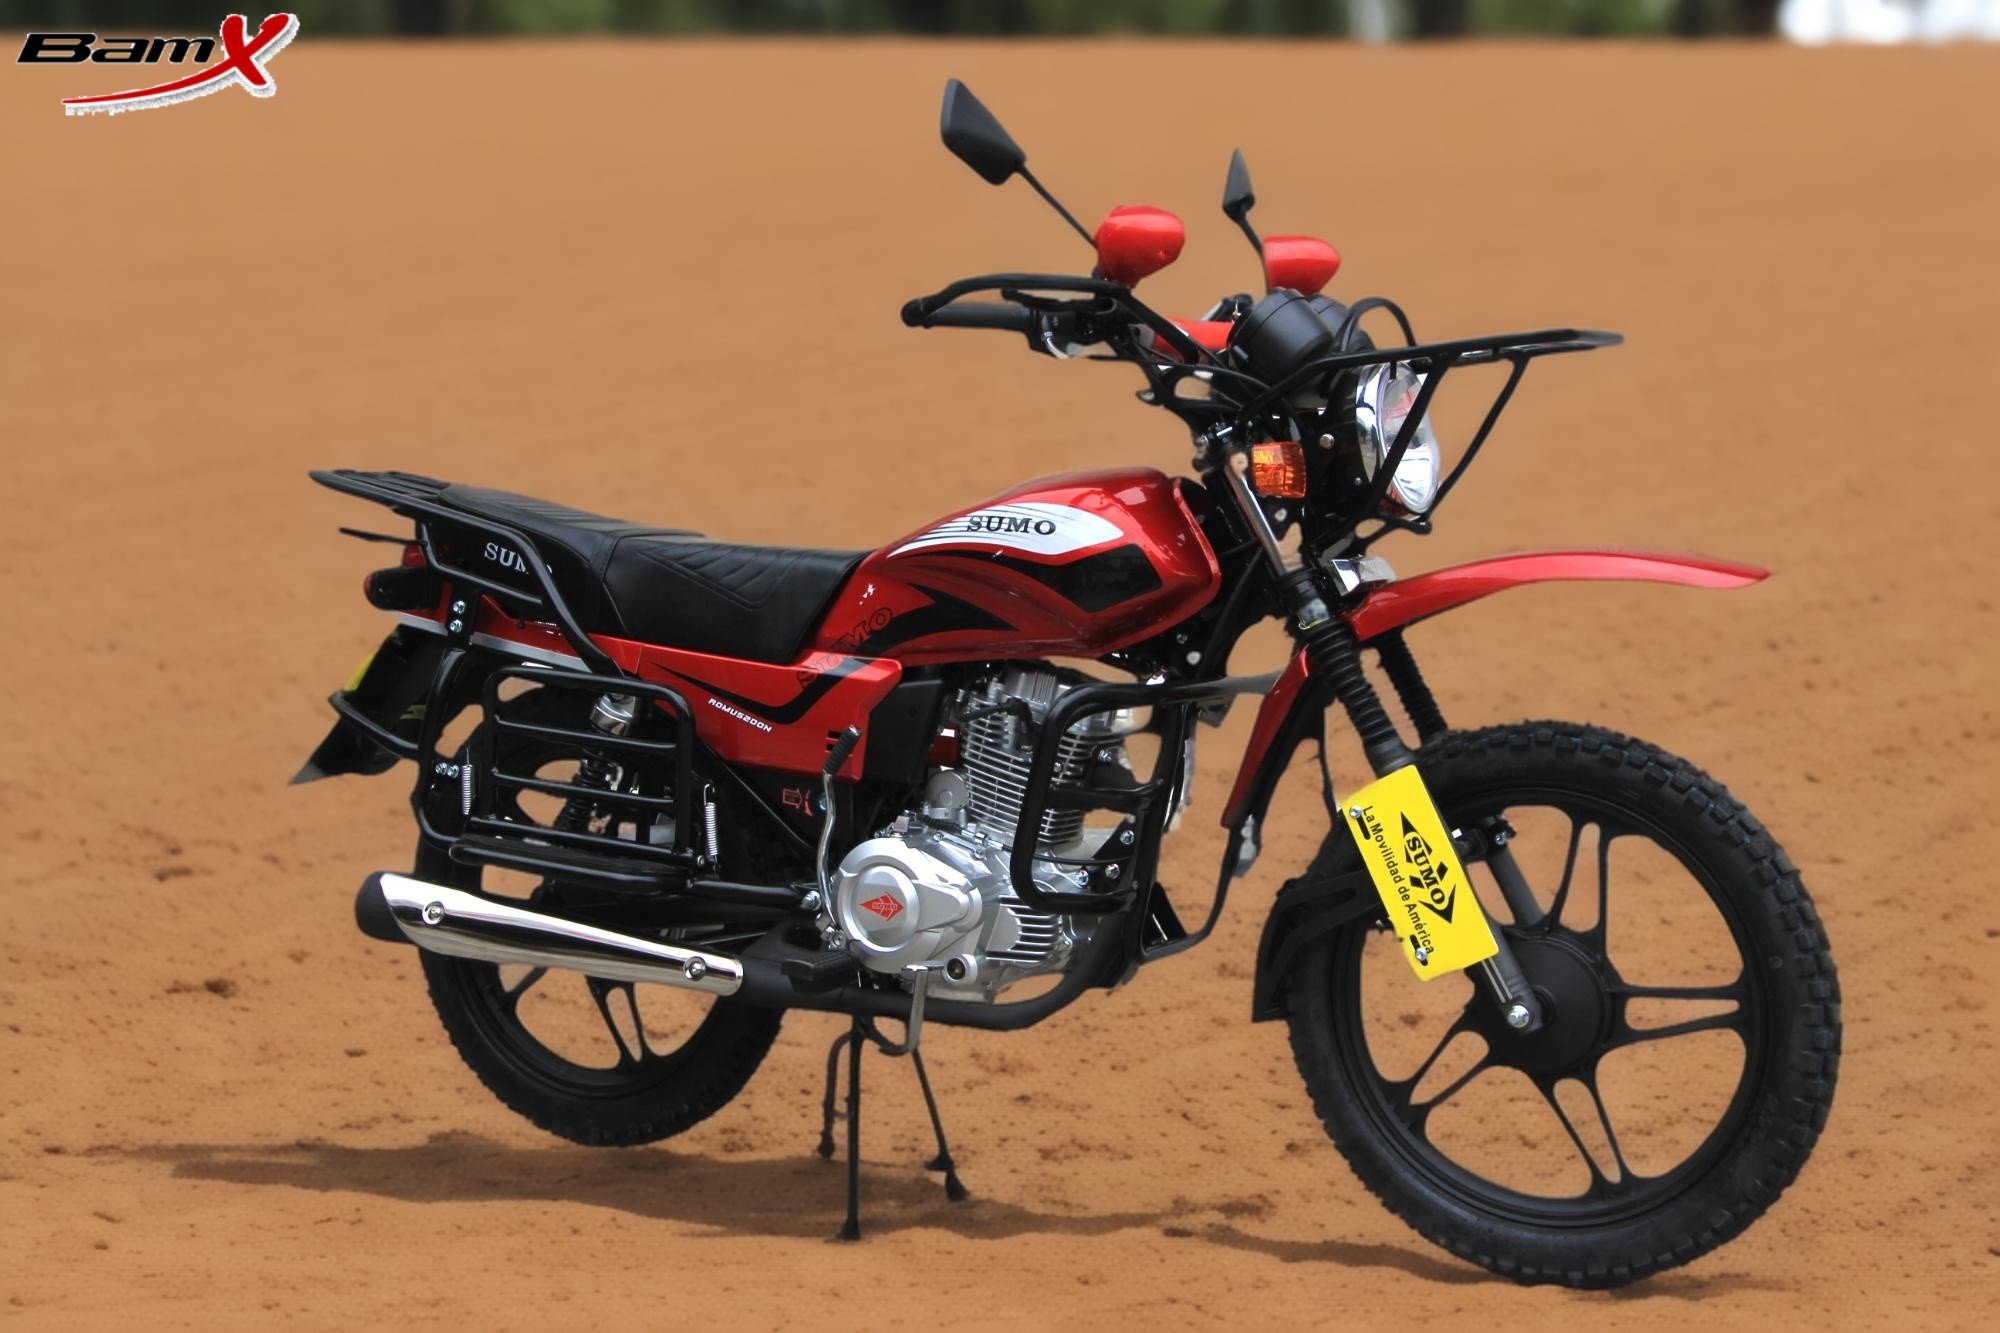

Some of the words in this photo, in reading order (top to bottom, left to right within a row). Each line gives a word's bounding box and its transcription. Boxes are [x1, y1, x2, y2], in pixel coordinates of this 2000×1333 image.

[966, 515, 1056, 535] SUMO
[484, 542, 552, 575] SU
[1362, 805, 1374, 822] La
[1370, 823, 1405, 884] Movilidad
[1397, 884, 1410, 901] de
[1405, 903, 1434, 954] América
[1405, 836, 1446, 905] SUMO
